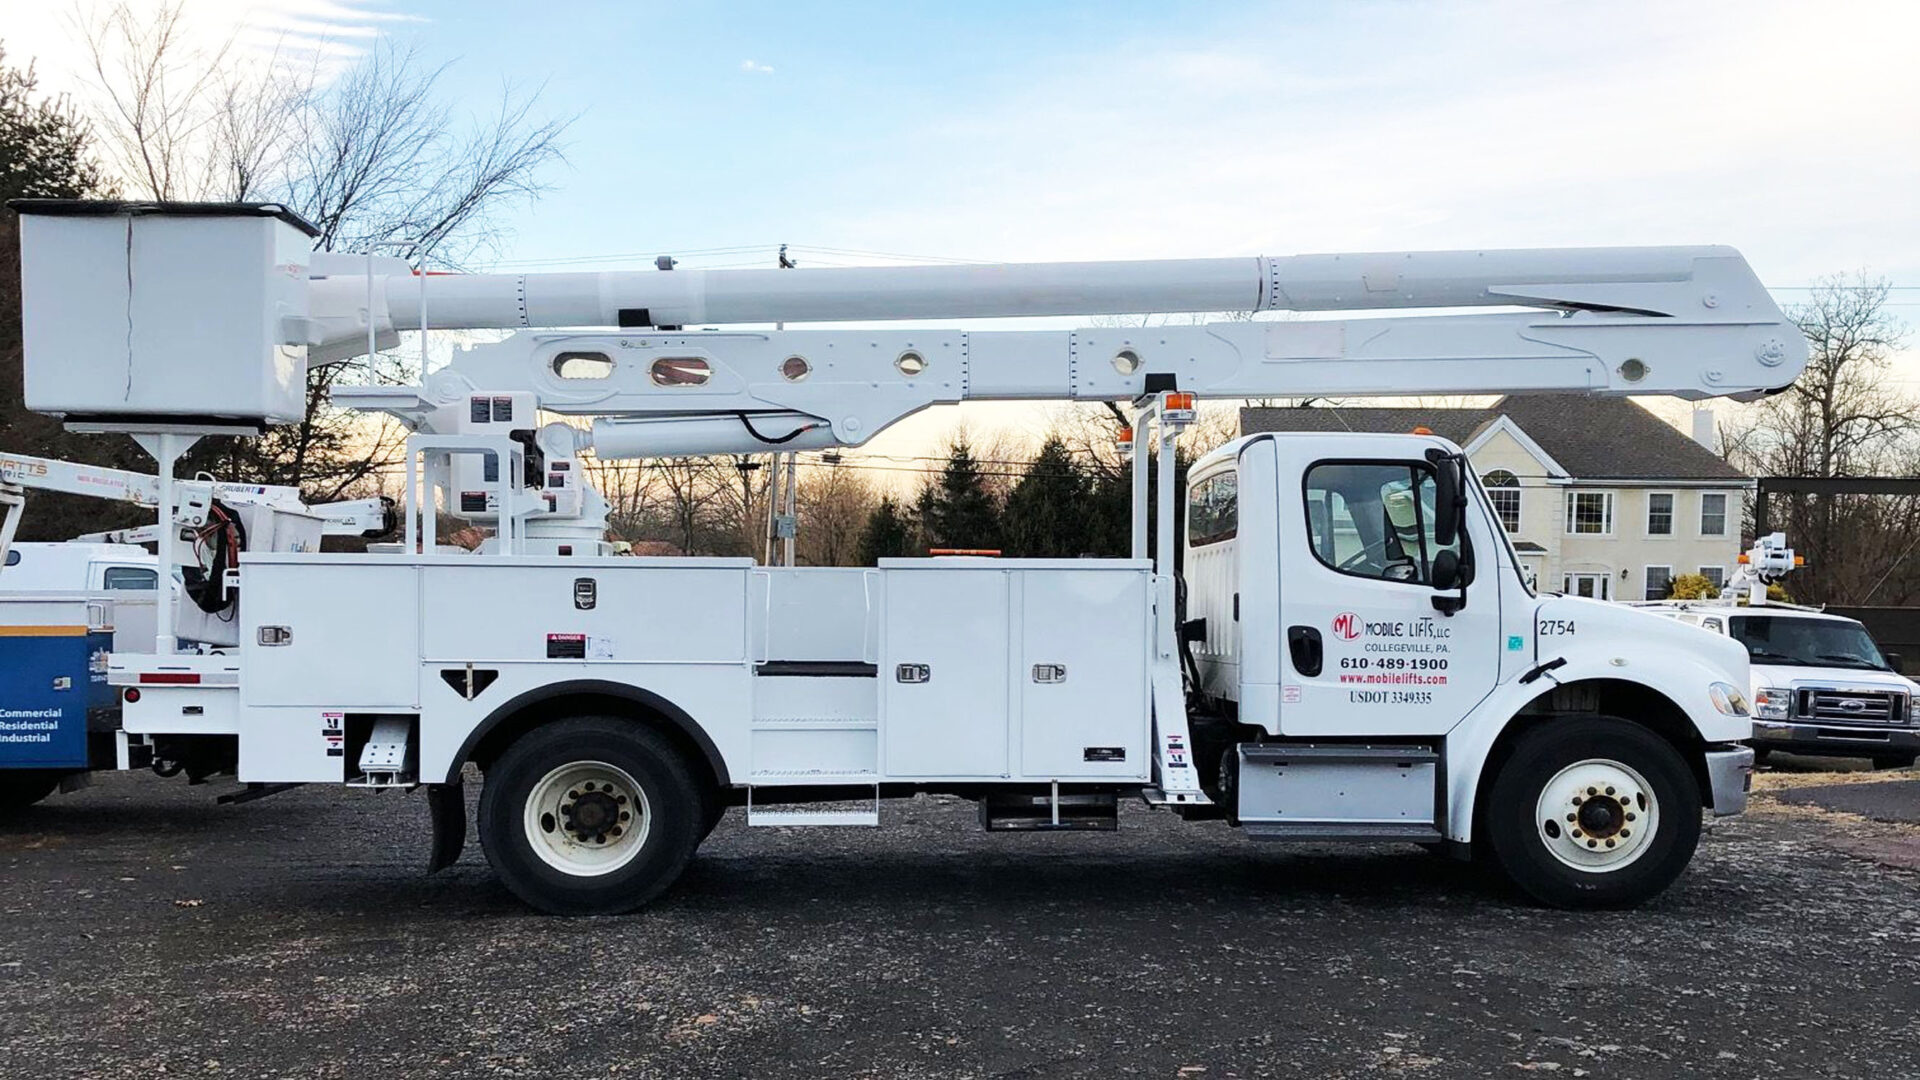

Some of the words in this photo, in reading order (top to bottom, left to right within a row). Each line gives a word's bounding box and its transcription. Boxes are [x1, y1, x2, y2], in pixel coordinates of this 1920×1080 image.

[1365, 622, 1404, 637] MOBILE
[1539, 620, 1575, 636] 2754
[1364, 643, 1434, 653] COLLEGEVILLE,
[1340, 673, 1448, 685] www.mobilelifts.com
[1350, 691, 1389, 704] USDOT
[1391, 691, 1432, 705] 3349335
[0, 708, 62, 718] Commercial
[0, 721, 58, 730] Residential
